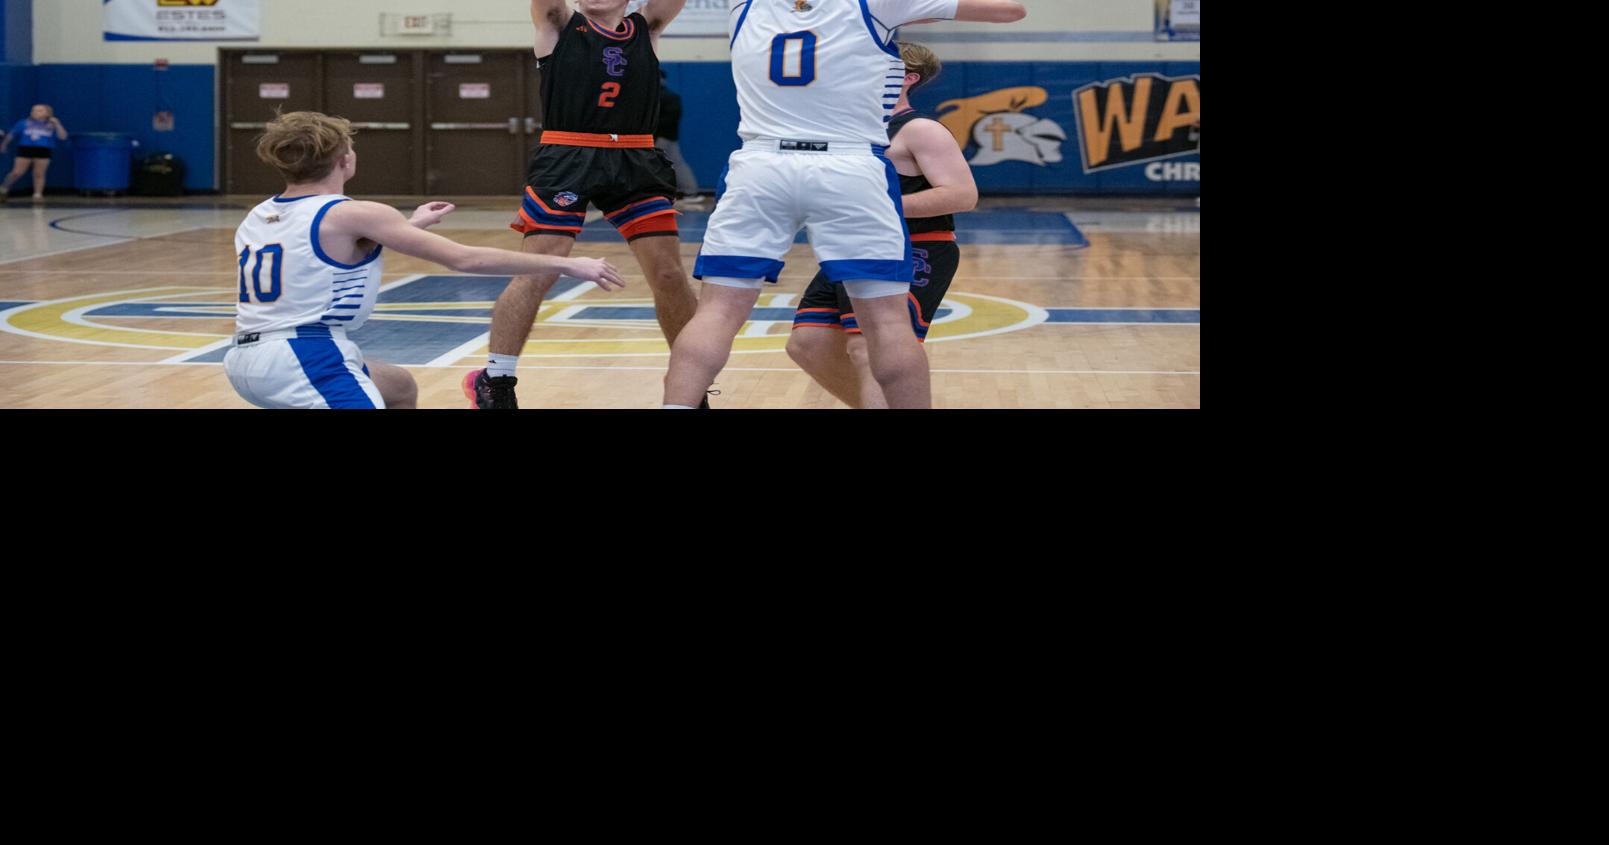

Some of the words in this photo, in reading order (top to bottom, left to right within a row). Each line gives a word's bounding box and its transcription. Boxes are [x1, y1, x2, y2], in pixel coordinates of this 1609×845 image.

[602, 46, 628, 77] SC
[768, 30, 817, 88] 0
[598, 81, 621, 108] 2
[1079, 77, 1200, 167] WA
[1145, 161, 1200, 181] CHR
[238, 243, 283, 303] 10
